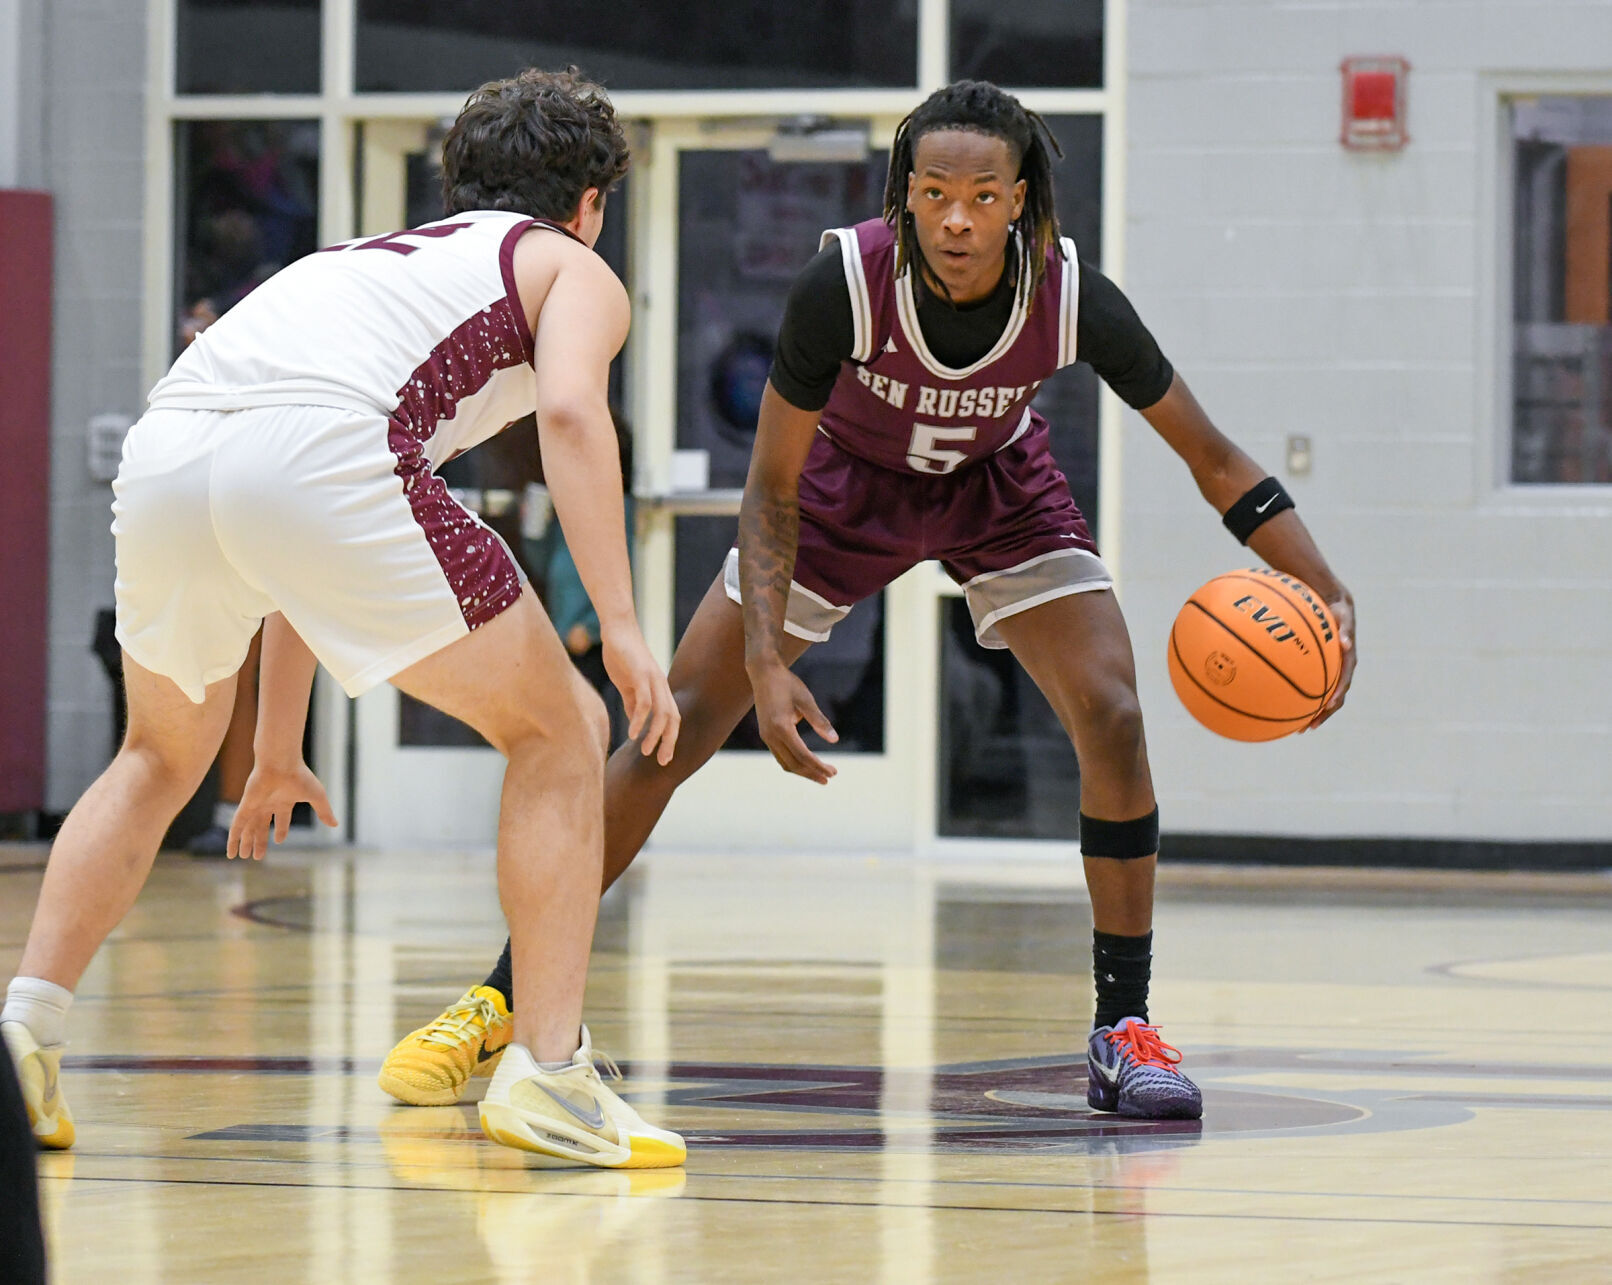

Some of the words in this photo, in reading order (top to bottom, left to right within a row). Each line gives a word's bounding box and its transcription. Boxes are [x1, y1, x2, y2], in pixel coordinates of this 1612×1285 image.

[857, 365, 909, 410] BEN
[915, 380, 1042, 418] RUSSE
[906, 422, 978, 475] 5
[1233, 595, 1296, 642] EVO
